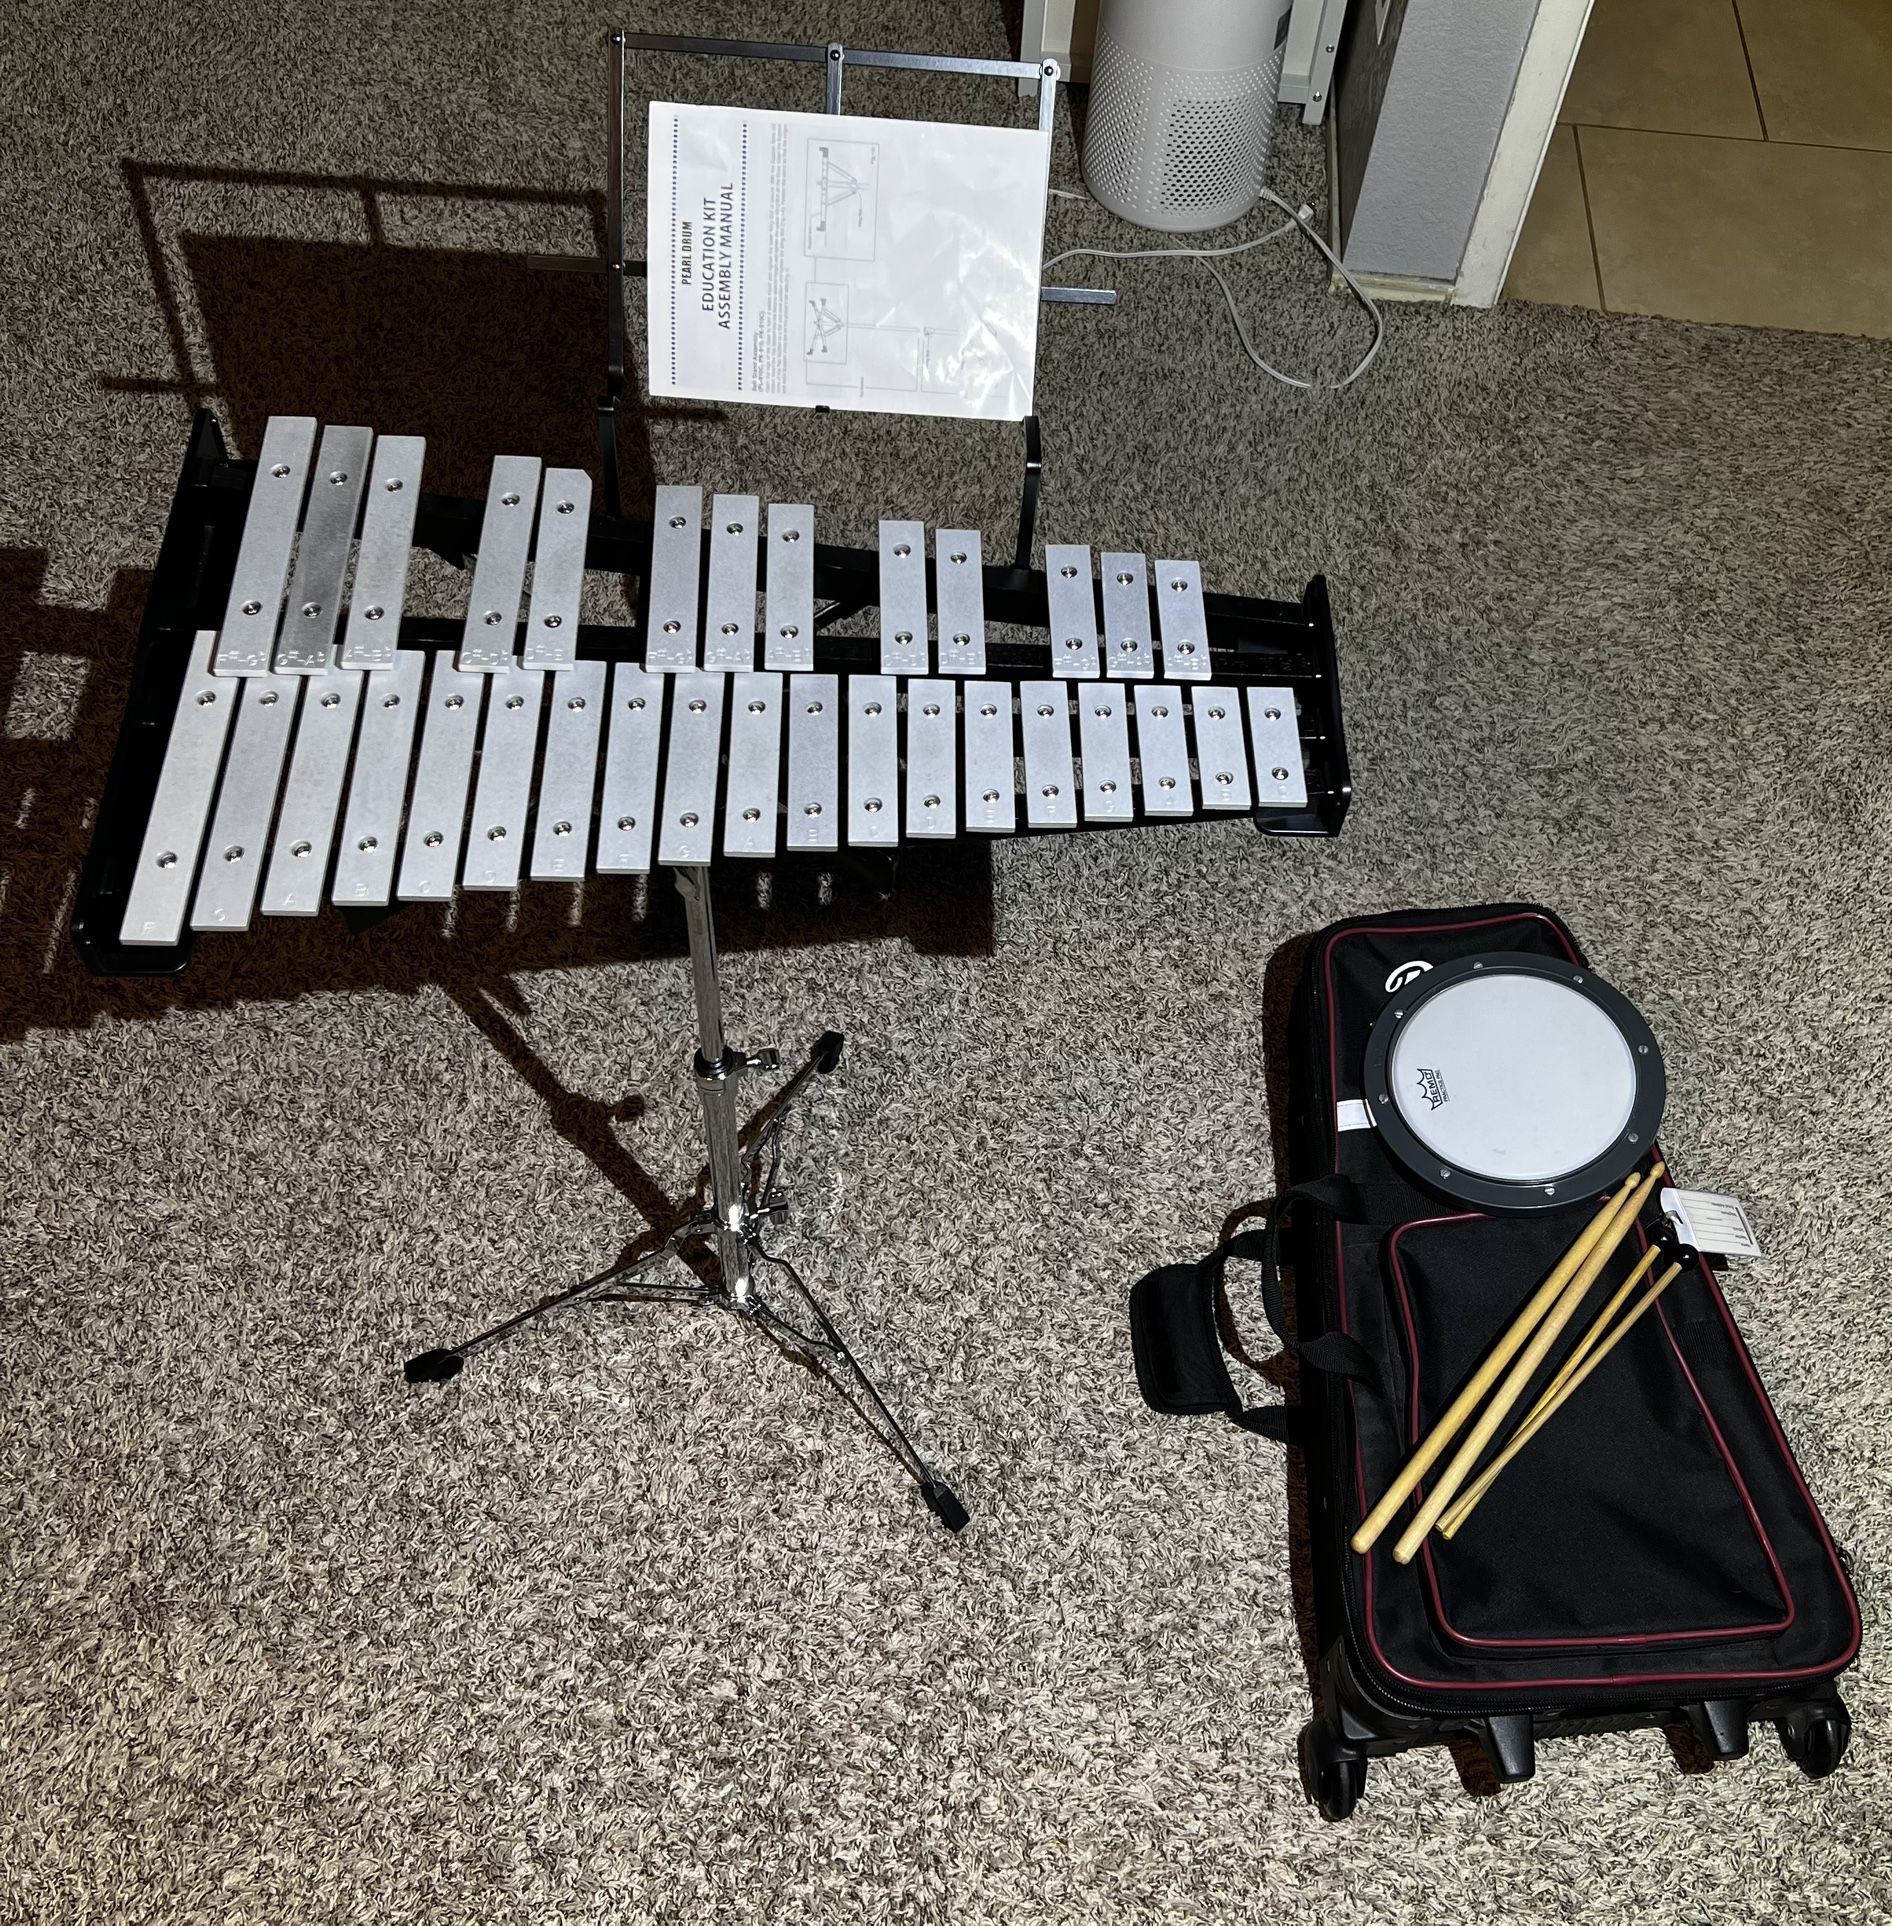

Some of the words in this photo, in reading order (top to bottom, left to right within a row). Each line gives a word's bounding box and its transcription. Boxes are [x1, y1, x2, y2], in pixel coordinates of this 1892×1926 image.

[703, 196, 717, 221] KIT
[719, 182, 734, 248] MANUAL
[681, 220, 693, 252] DRUM
[681, 254, 693, 286] PEARL
[701, 225, 716, 312] EDUCATION
[717, 250, 732, 330] ASSEMBLY
[281, 891, 296, 906] A
[1424, 1071, 1441, 1103] REMO
